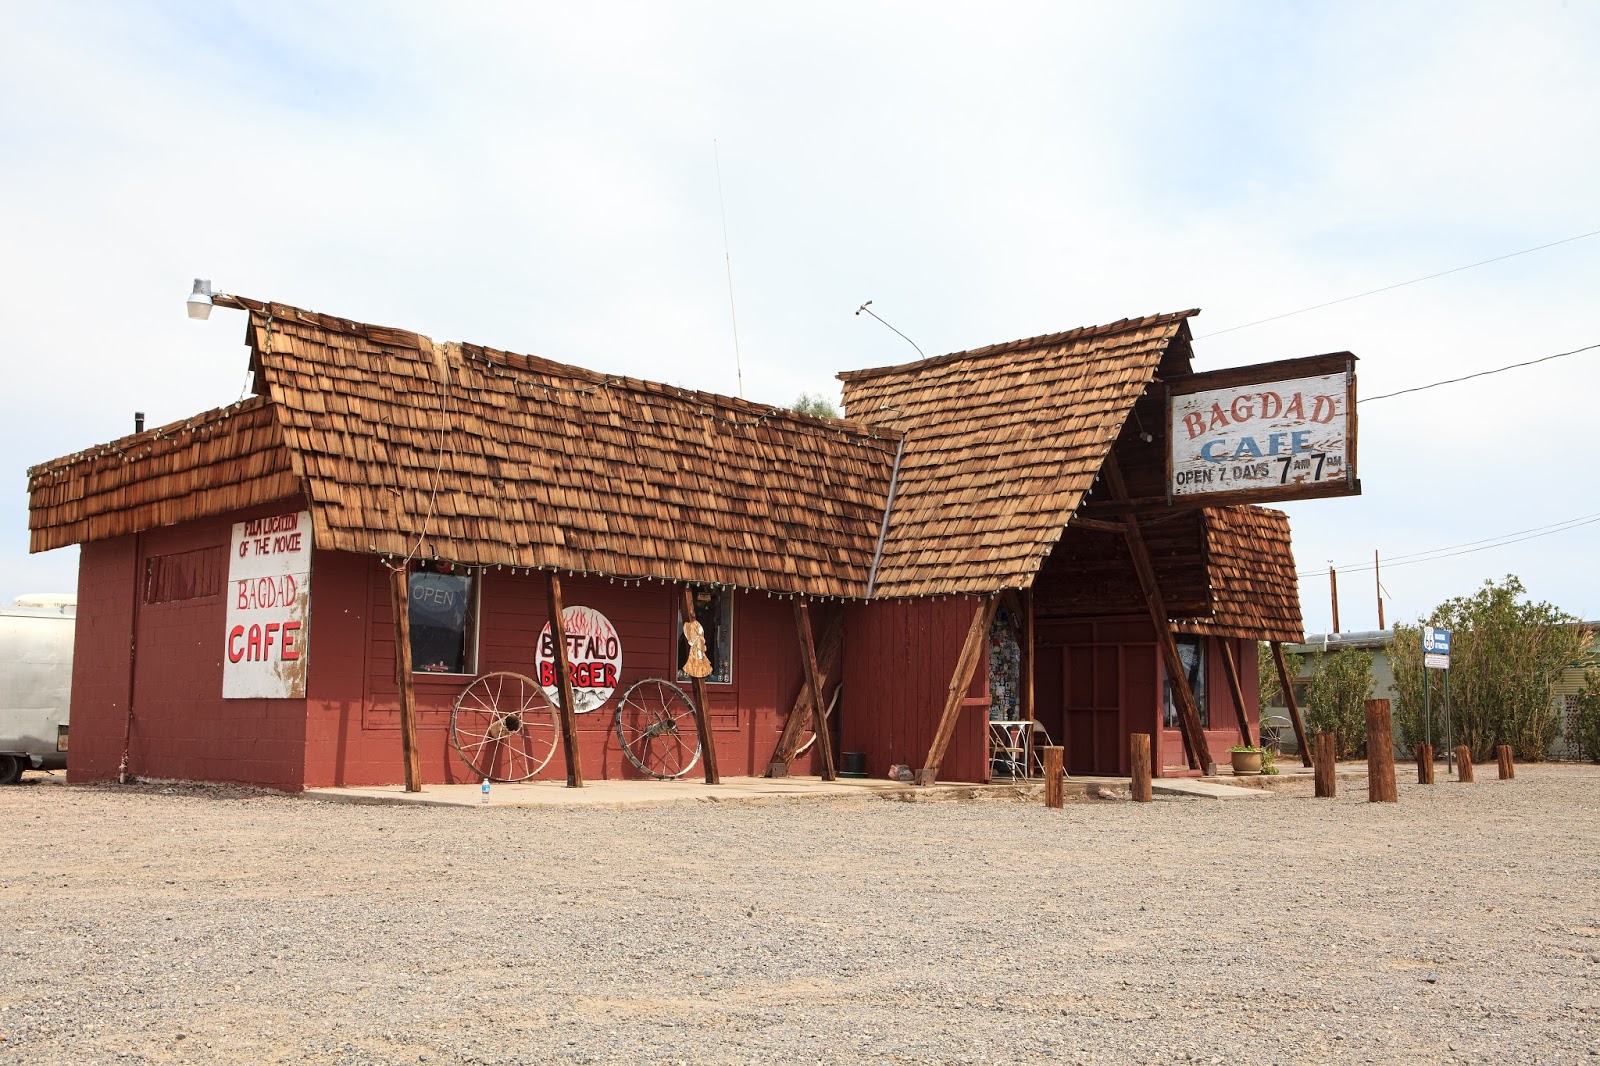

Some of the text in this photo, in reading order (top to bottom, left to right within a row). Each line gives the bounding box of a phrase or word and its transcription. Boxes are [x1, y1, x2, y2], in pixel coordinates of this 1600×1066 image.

[1181, 391, 1336, 441] BAGDAD
[1200, 429, 1313, 463] CAFE
[1176, 468, 1212, 486] OPEN
[1218, 467, 1227, 481] 7
[1233, 463, 1269, 480] DAYS
[1277, 456, 1292, 484] 7
[1311, 453, 1326, 481] 7
[239, 532, 302, 558] OF THE MOVIE
[237, 574, 297, 610] BAGDAD
[413, 585, 454, 606] OPEN
[228, 621, 301, 664] CAFE
[541, 633, 619, 660] BFALO
[1425, 634, 1434, 648] 66
[540, 660, 617, 688] BRGER
